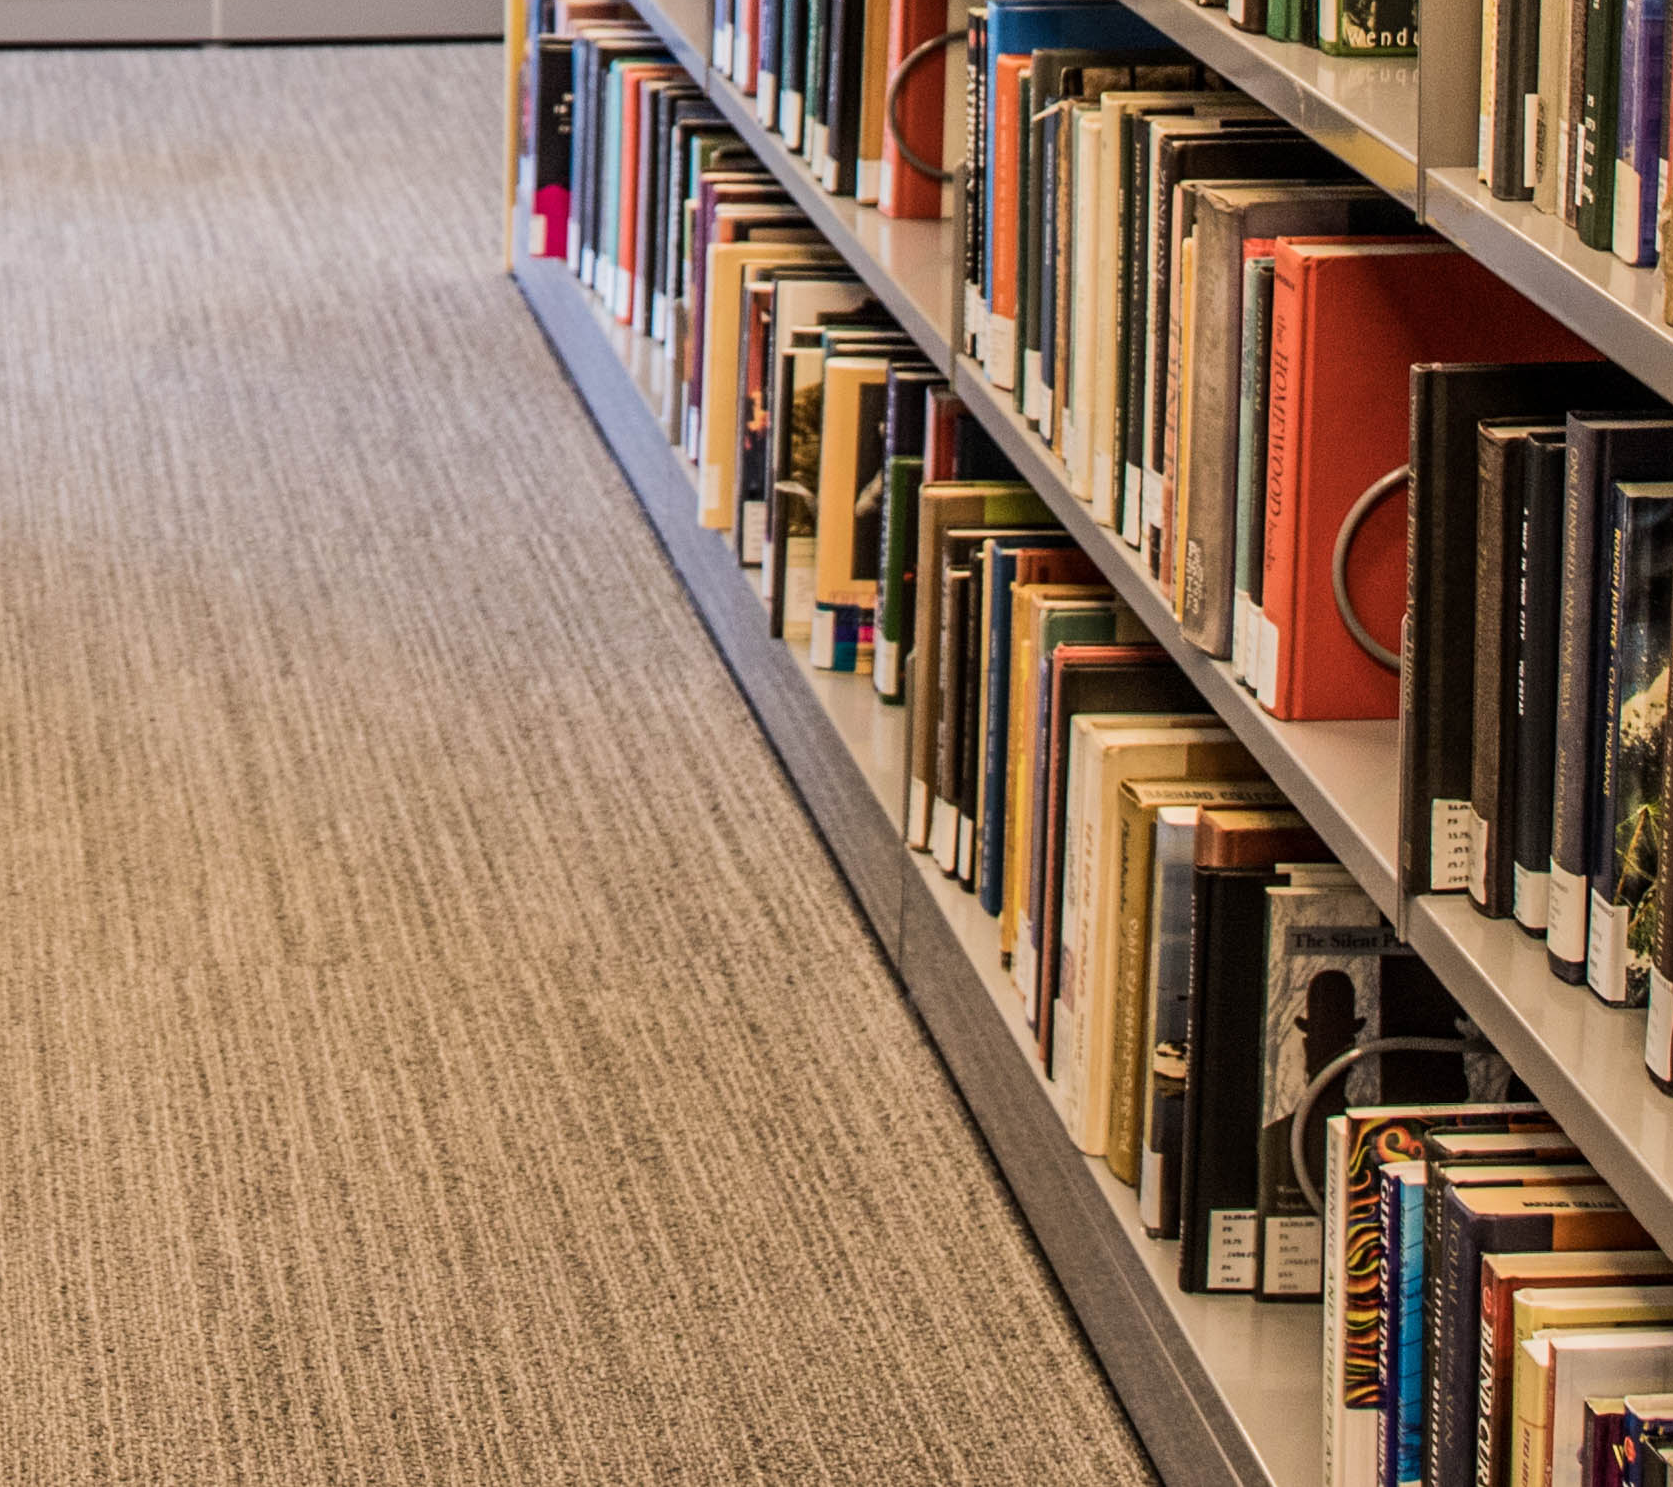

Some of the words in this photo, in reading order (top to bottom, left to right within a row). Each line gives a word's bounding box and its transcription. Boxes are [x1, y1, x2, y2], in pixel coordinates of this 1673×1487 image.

[1376, 1178, 1391, 1243] GIFT
[1376, 1257, 1390, 1298] OF
[1375, 1306, 1390, 1386] TIME
[1479, 1319, 1494, 1416] BLIND
